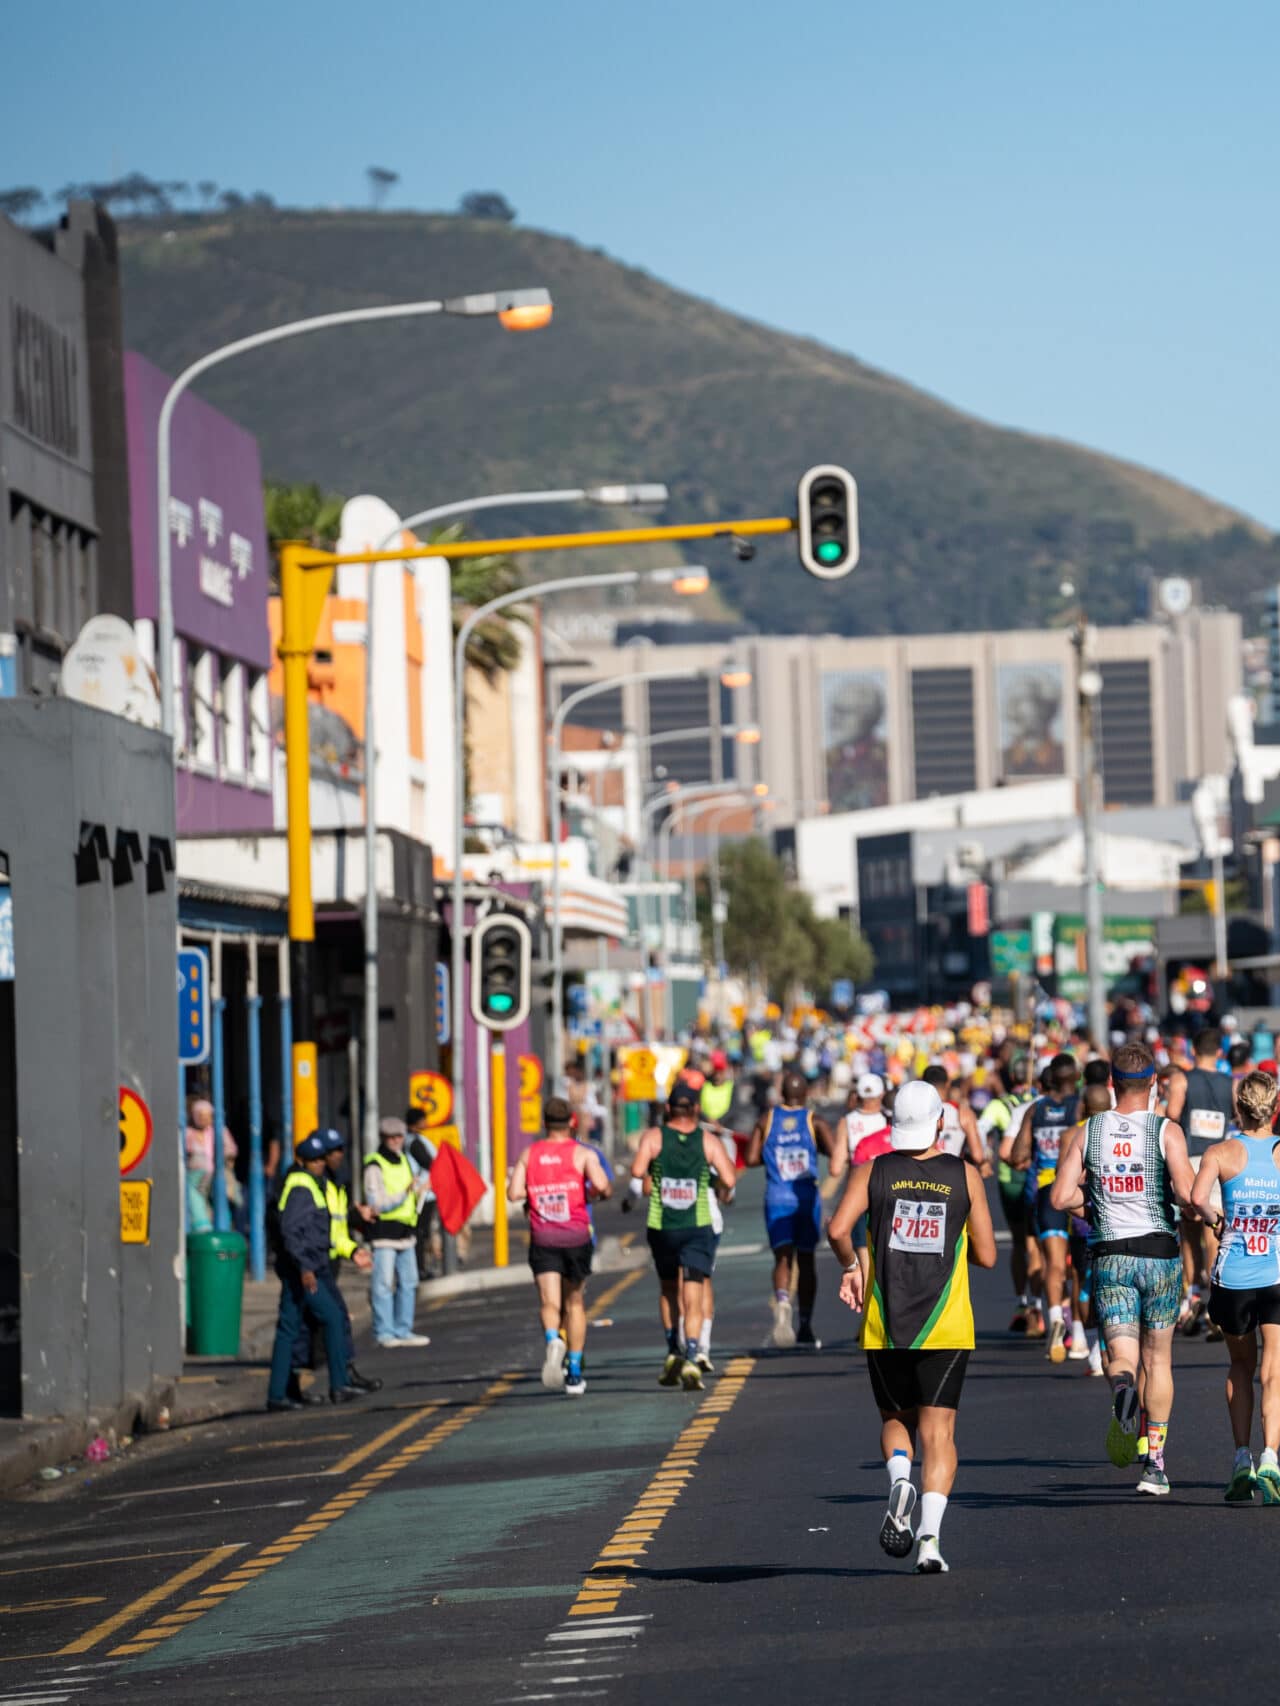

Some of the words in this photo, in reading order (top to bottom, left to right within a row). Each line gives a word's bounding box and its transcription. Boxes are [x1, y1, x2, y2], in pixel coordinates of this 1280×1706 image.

[1113, 1143, 1132, 1157] 40
[891, 1180, 952, 1195] uMHLATHUZE
[1244, 1177, 1278, 1188] Maluti
[1247, 1236, 1268, 1253] 40
